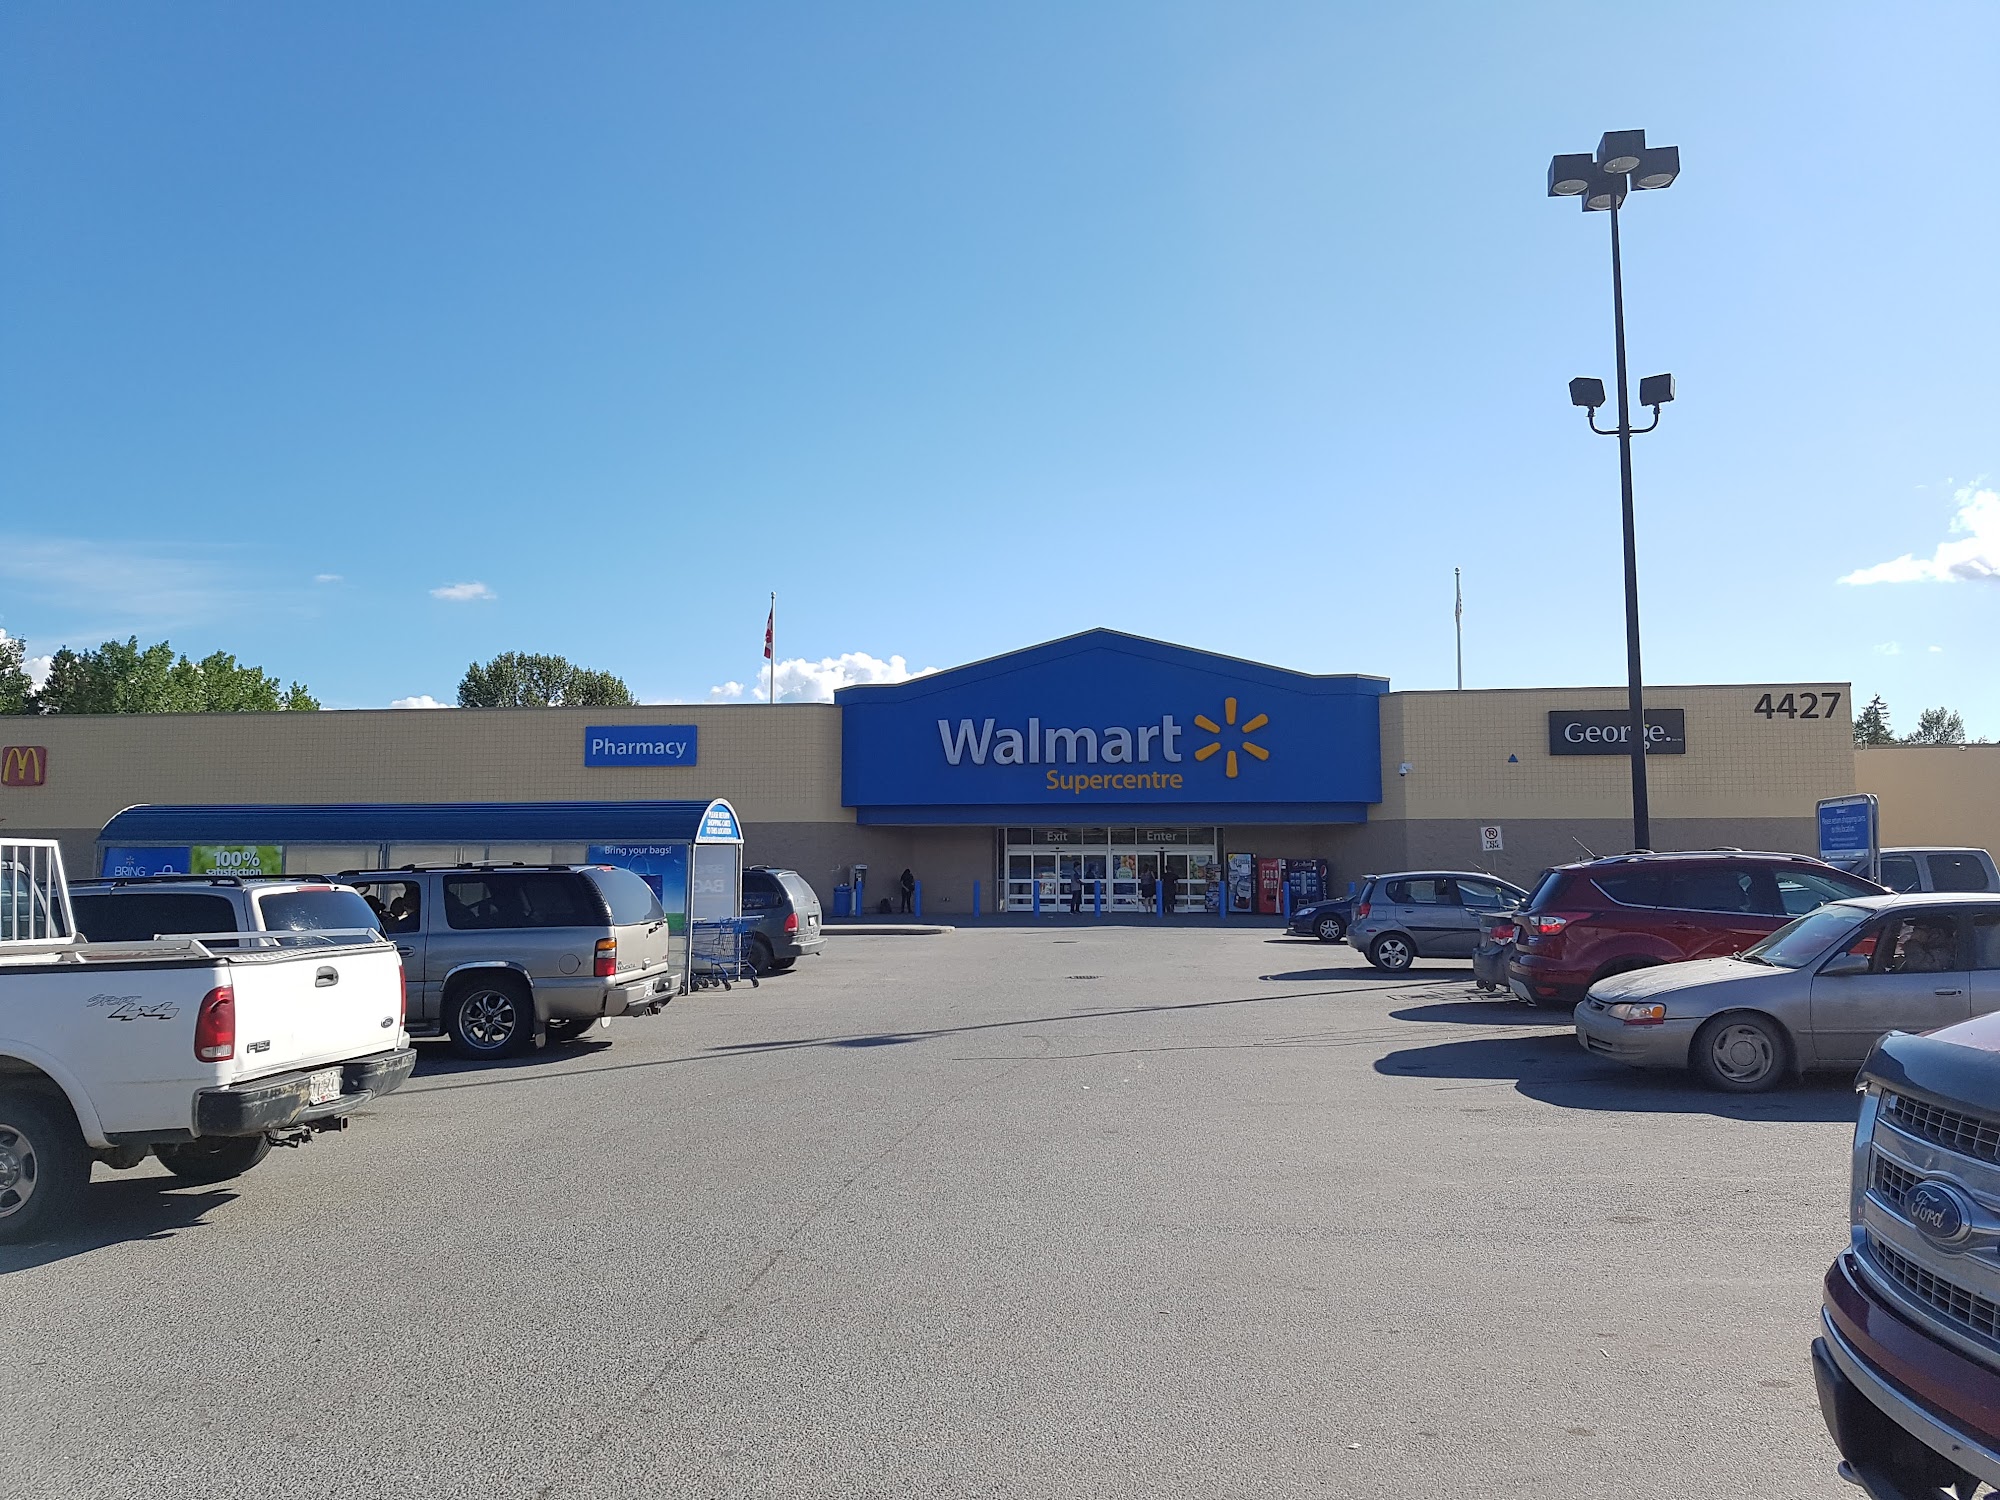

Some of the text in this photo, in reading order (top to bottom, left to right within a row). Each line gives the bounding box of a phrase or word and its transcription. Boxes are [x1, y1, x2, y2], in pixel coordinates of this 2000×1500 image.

[1754, 692, 1841, 719] 4427
[937, 715, 1182, 765] Walmart
[592, 738, 687, 759] Pharmacy
[1046, 769, 1183, 794] Supercentre
[1047, 831, 1068, 841] Exit
[1147, 831, 1177, 841] Enter
[213, 851, 261, 867] 100%
[604, 845, 672, 857] Bring your bags!
[114, 866, 146, 877] BRING
[205, 866, 262, 876] satisfaction
[1910, 1190, 1947, 1228] Ford
